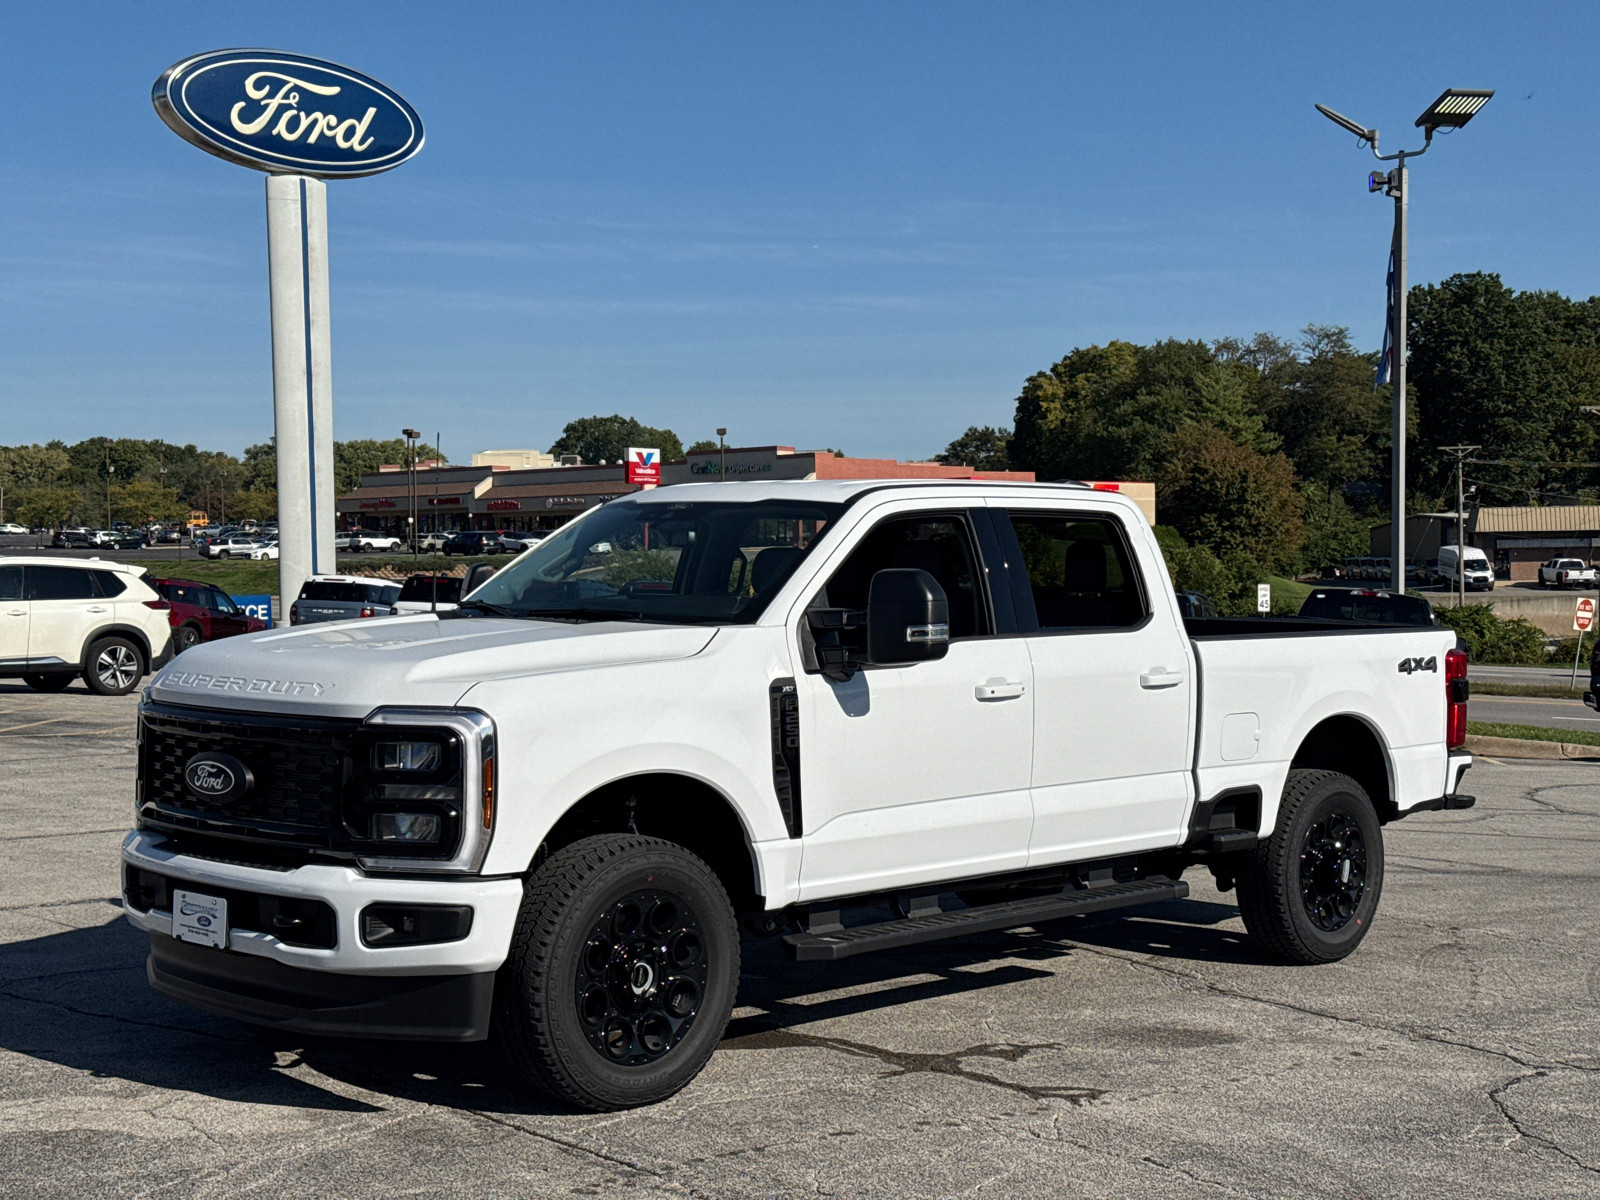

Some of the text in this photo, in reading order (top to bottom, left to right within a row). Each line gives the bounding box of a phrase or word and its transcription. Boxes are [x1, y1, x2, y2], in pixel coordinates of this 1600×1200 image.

[230, 71, 377, 152] Ford
[1260, 600, 1268, 608] 45
[165, 671, 336, 697] SUPER DUTY
[194, 765, 224, 790] Ford
